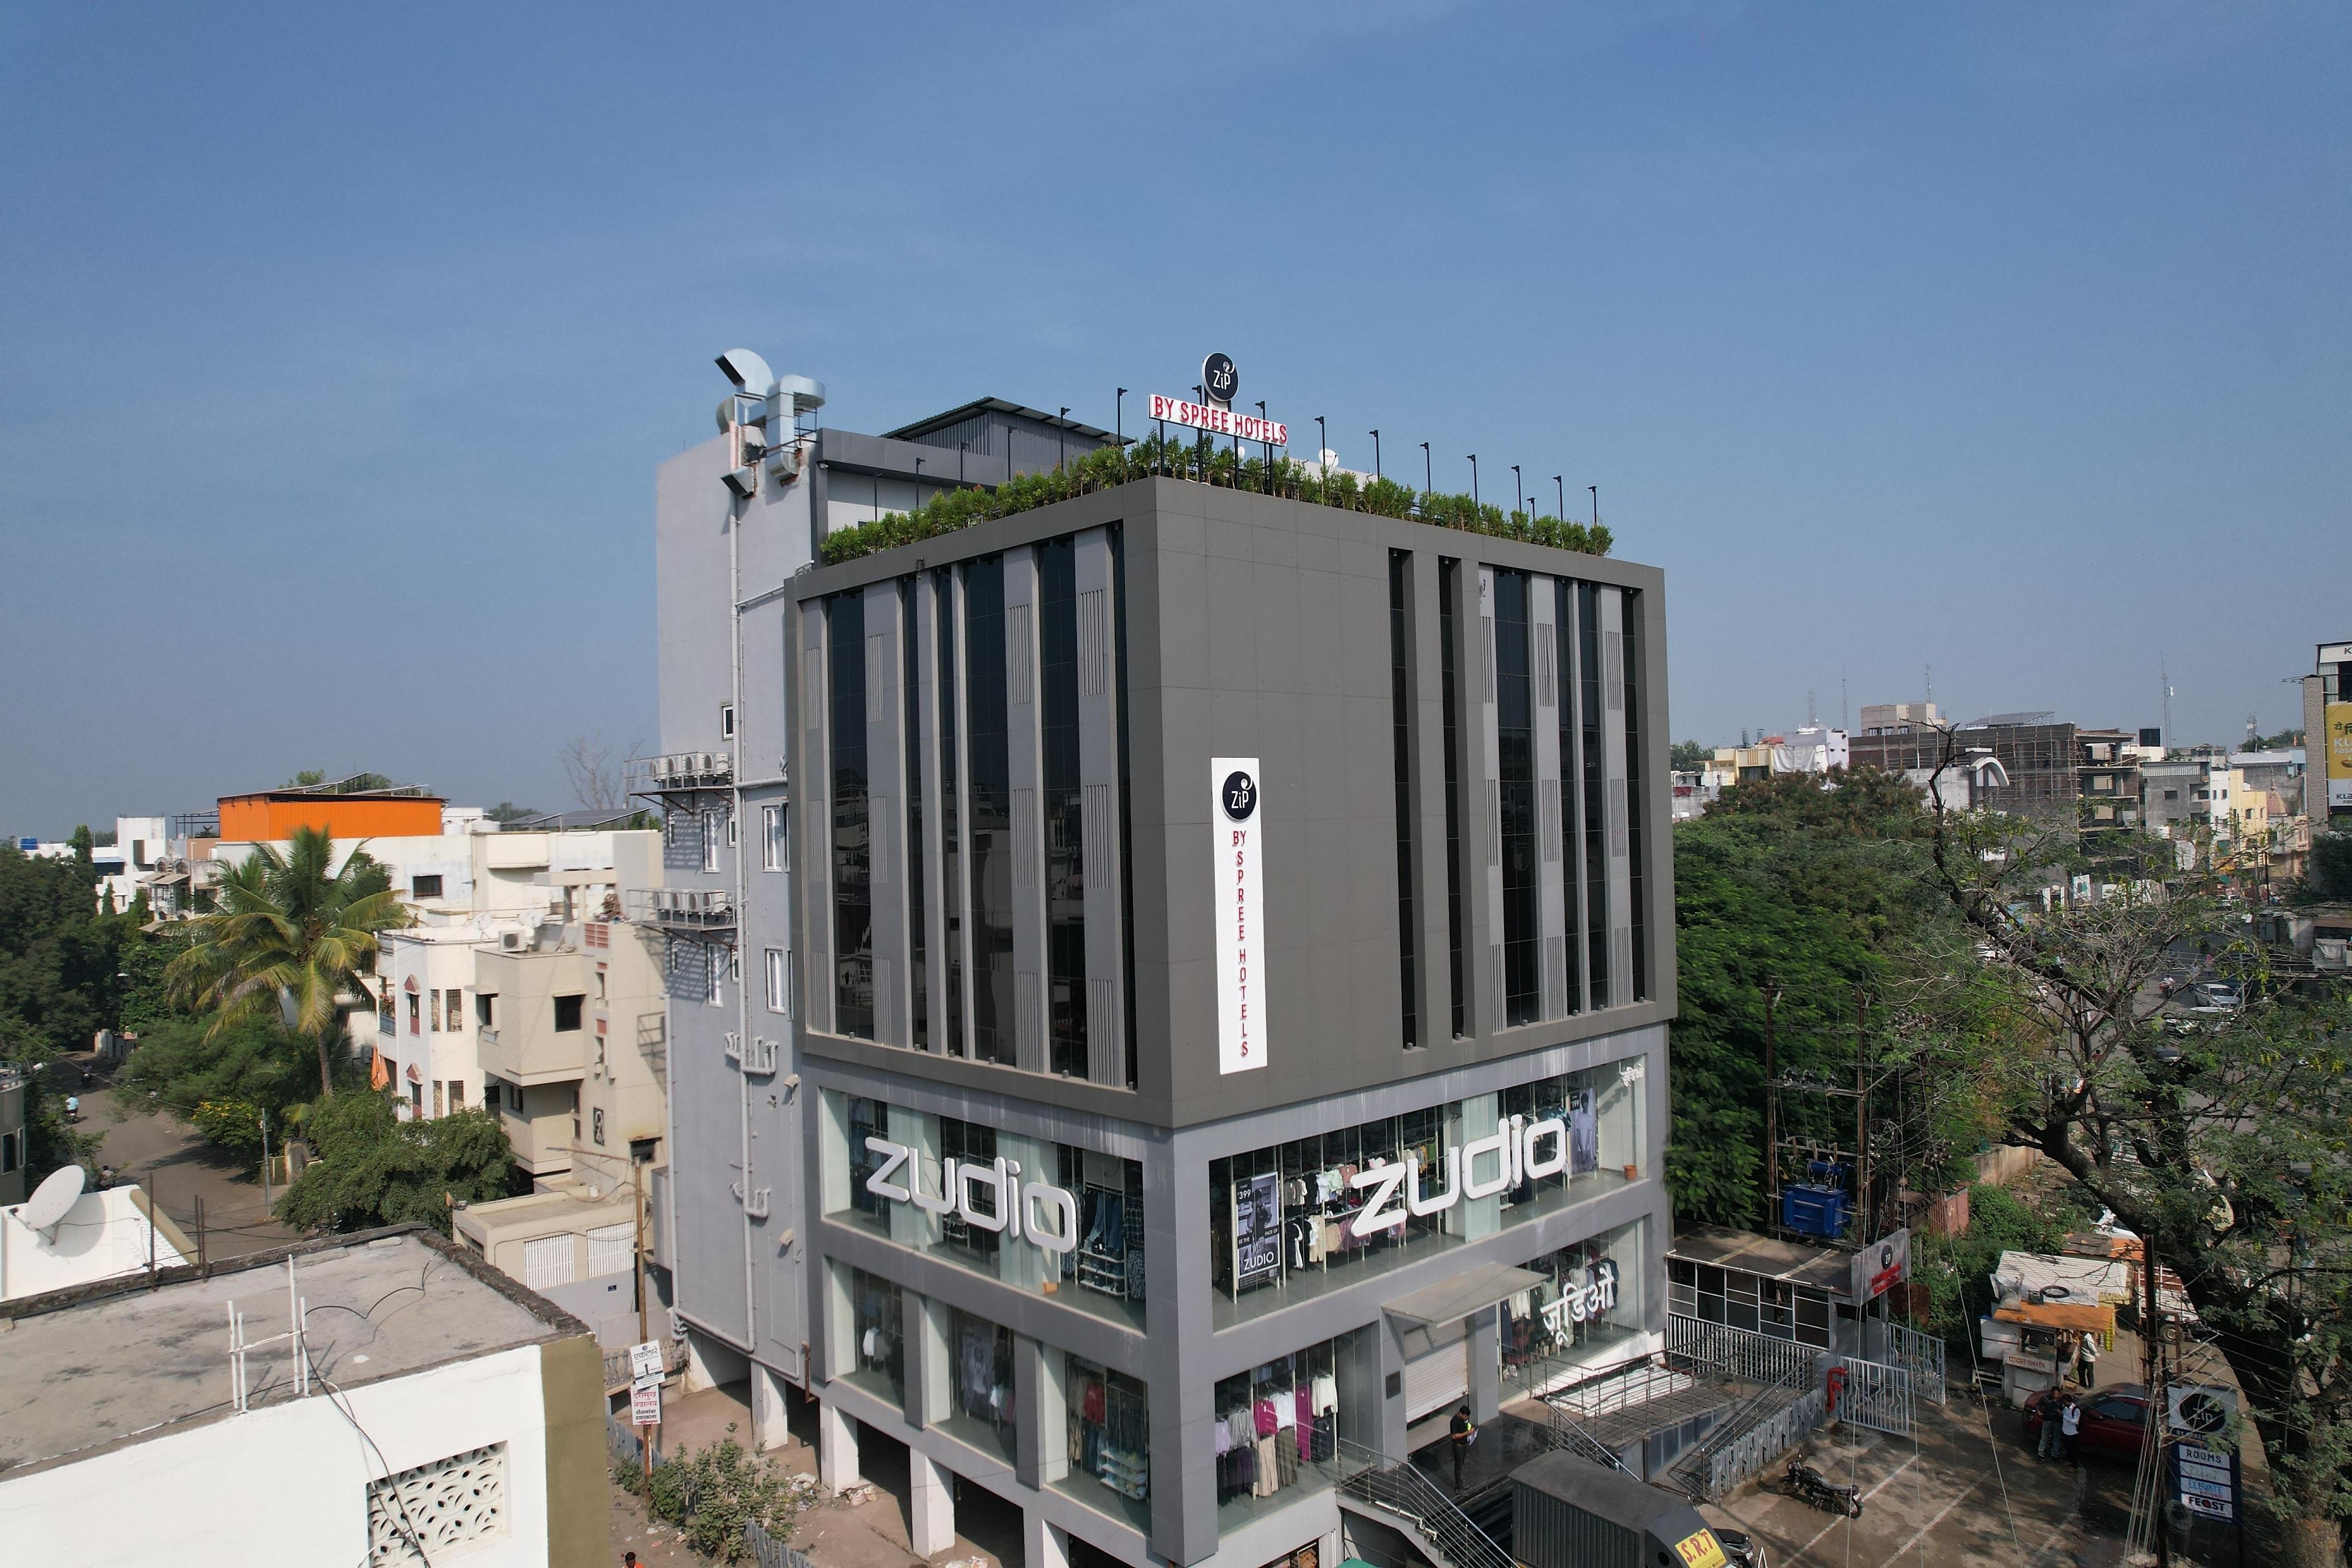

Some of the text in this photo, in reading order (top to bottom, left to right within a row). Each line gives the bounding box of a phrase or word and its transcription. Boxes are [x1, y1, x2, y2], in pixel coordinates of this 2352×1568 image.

[1154, 396, 1288, 444] BY SPREE HOTELS
[1232, 831, 1247, 846] BY
[1236, 850, 1245, 941] SPREE
[1239, 949, 1249, 1057] HOTELS
[1244, 1251, 1274, 1271] ZUDIO
[2186, 1449, 2221, 1463] ROOMS
